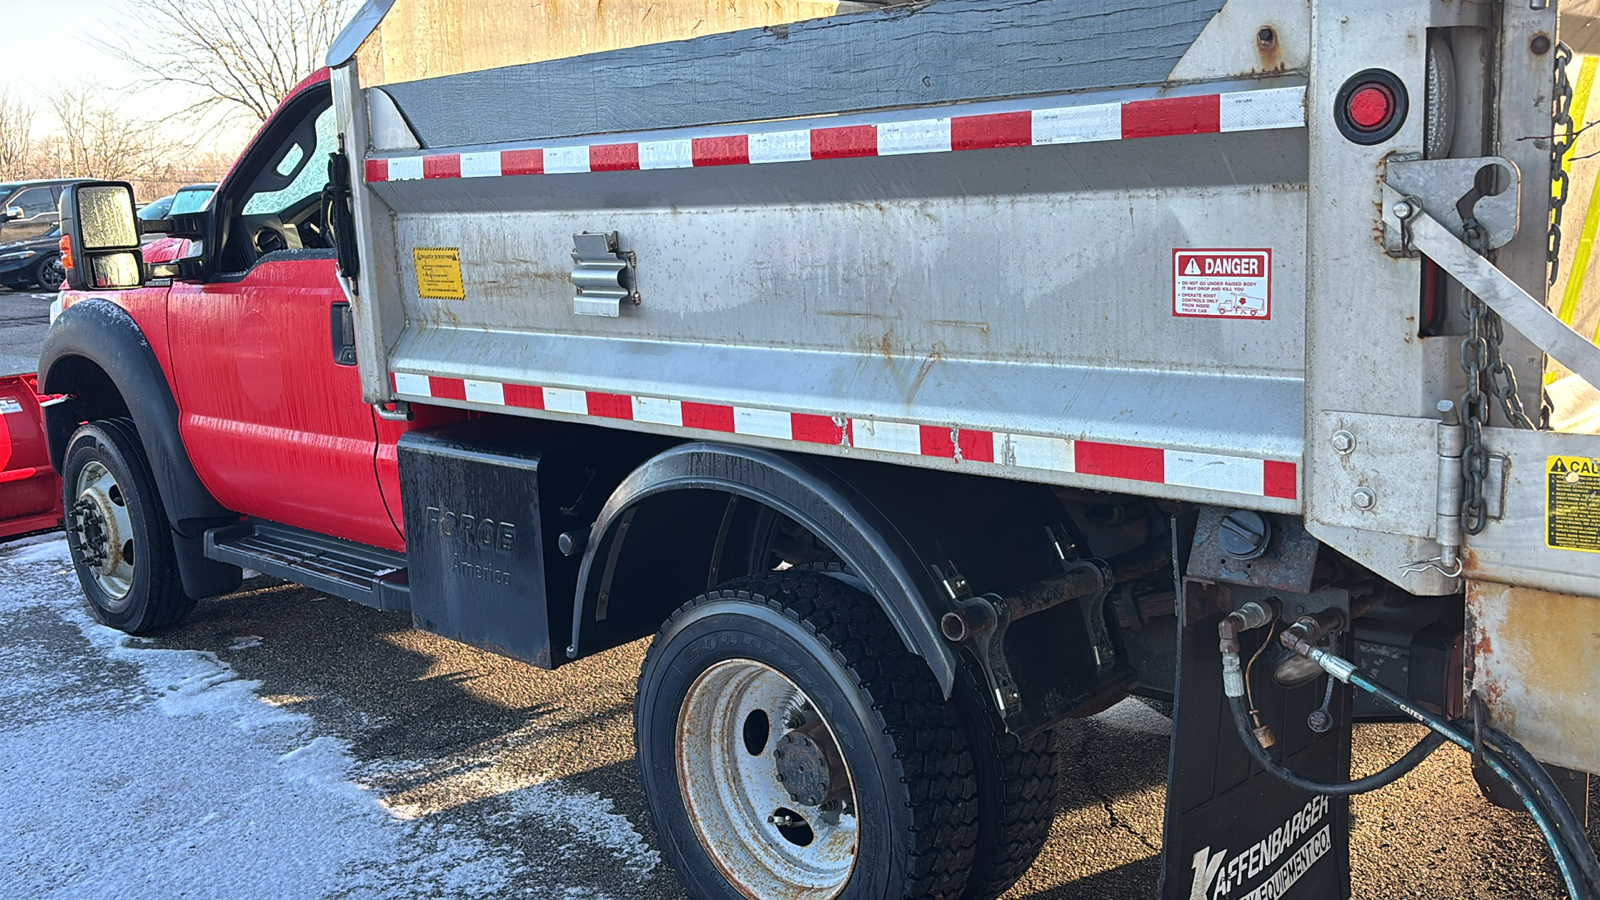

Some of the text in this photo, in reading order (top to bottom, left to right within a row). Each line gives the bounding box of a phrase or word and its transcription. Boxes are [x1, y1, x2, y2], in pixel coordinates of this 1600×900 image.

[1205, 258, 1258, 274] DANGER
[1400, 704, 1424, 721] GATES
[1189, 794, 1329, 900] KAFFENBARGER
[1260, 830, 1330, 900] EQUIPMENT CO.
